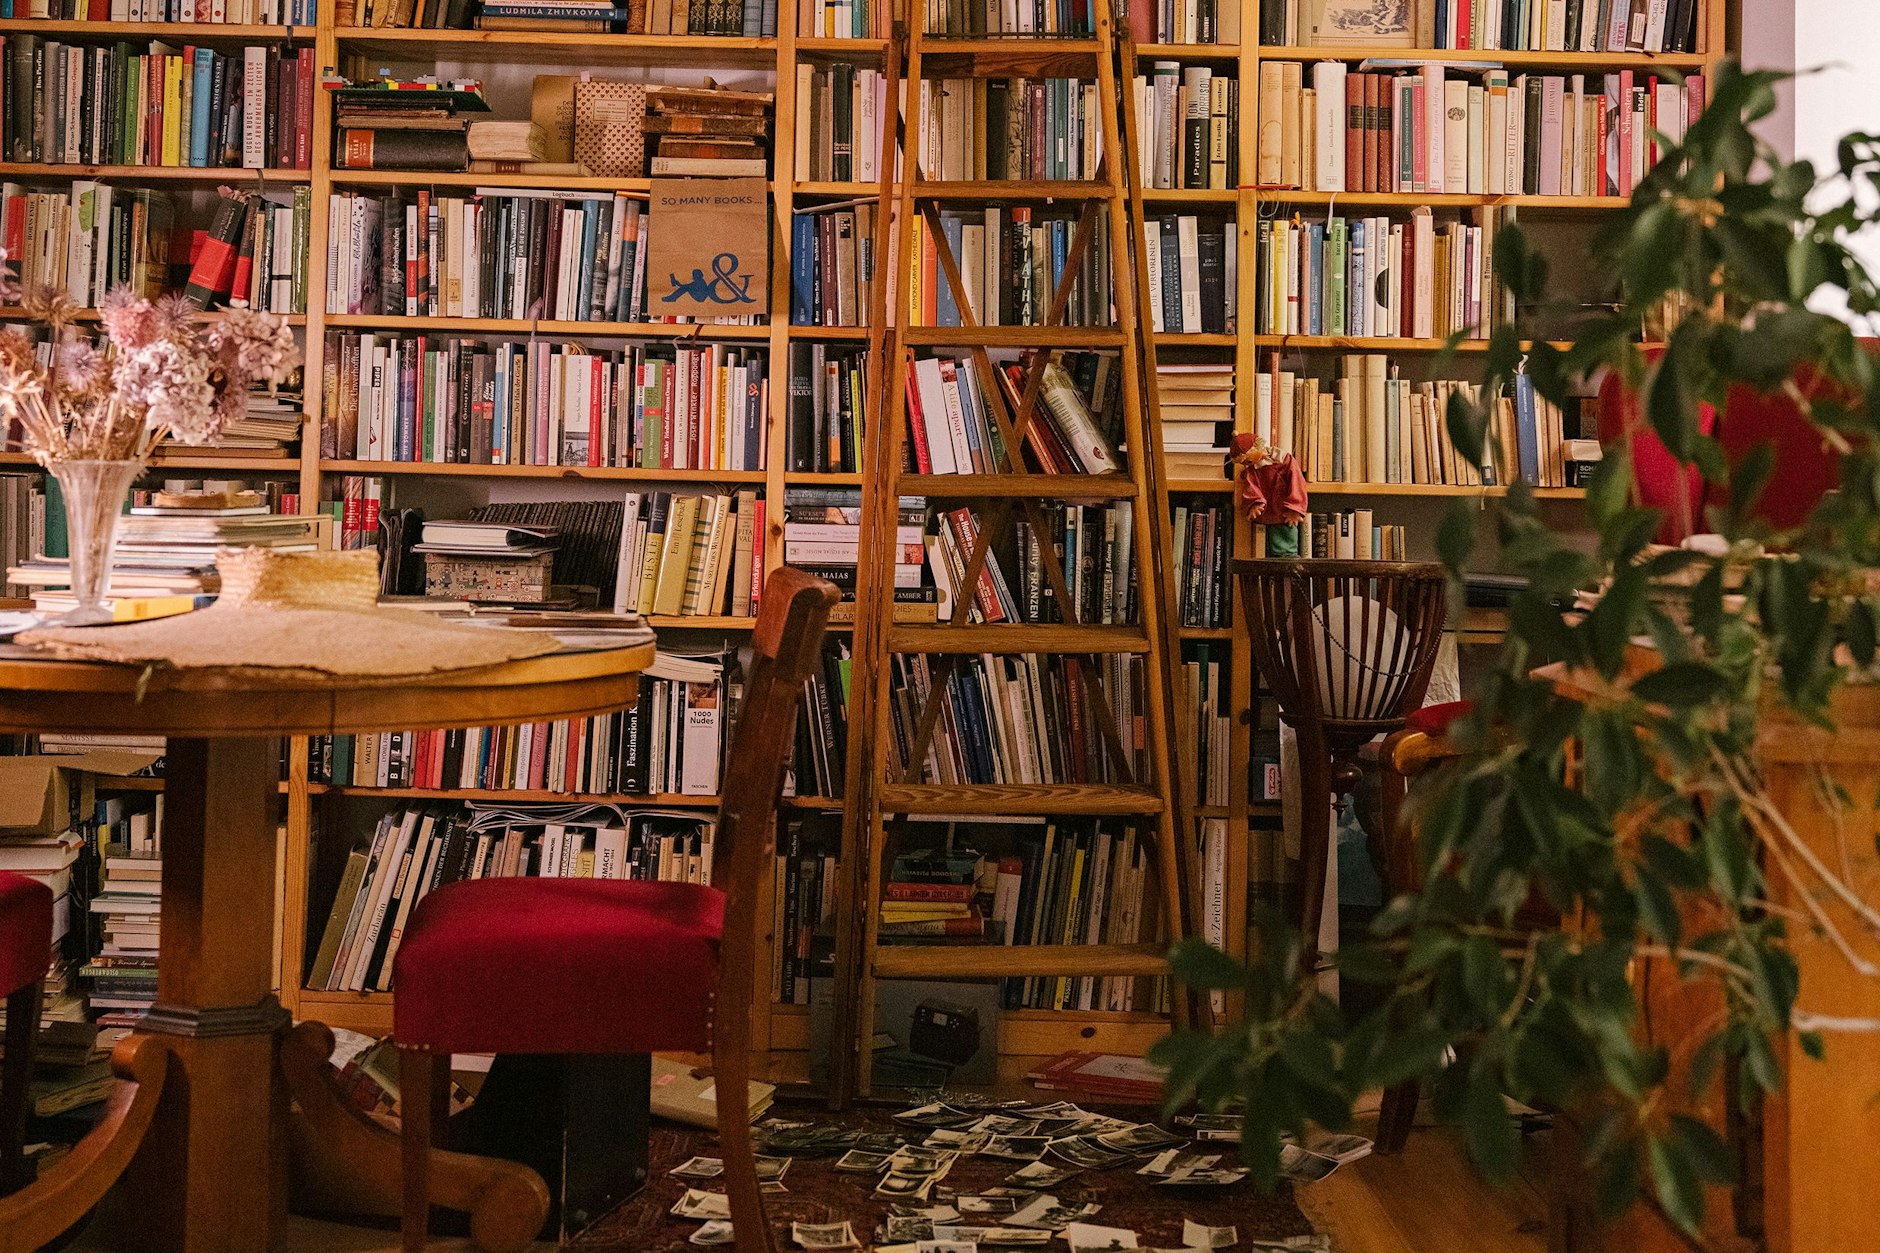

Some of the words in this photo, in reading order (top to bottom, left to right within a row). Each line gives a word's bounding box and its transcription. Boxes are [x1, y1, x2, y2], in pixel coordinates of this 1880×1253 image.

[500, 8, 543, 16] LUDMILA
[548, 8, 600, 16] ZHIVKOVA
[212, 62, 221, 110] RUSSENDISKO
[1622, 88, 1632, 134] Schwestern
[254, 140, 262, 154] DES
[1508, 124, 1516, 157] RITTER
[661, 197, 676, 206] SO
[679, 196, 711, 204] MANY
[714, 196, 762, 205] BOOKS...
[624, 250, 634, 288] BIERESCH
[1021, 209, 1031, 327] LEVIATHAN
[1148, 239, 1157, 292] VERLORENEN
[350, 346, 359, 396] Unverhofften
[350, 400, 358, 411] Die
[952, 410, 962, 436] apart
[672, 500, 685, 532] Lesebuch
[960, 520, 972, 542] House
[644, 540, 656, 580] BESTE
[670, 542, 679, 554] Ein
[704, 563, 714, 590] MUSEUM
[710, 504, 725, 550] WUNDERVOLLEN
[752, 555, 760, 596] Erkundungen
[1030, 572, 1038, 618] FRANZEN
[1104, 577, 1112, 613] DISGRACE
[690, 716, 714, 725] Nudes
[364, 737, 372, 764] WALTER
[390, 736, 401, 779] BILD
[626, 716, 638, 766] Faszination
[601, 848, 610, 878] RMACHT
[366, 902, 387, 944] Zurbarán
[1210, 881, 1222, 930] Zeichner
